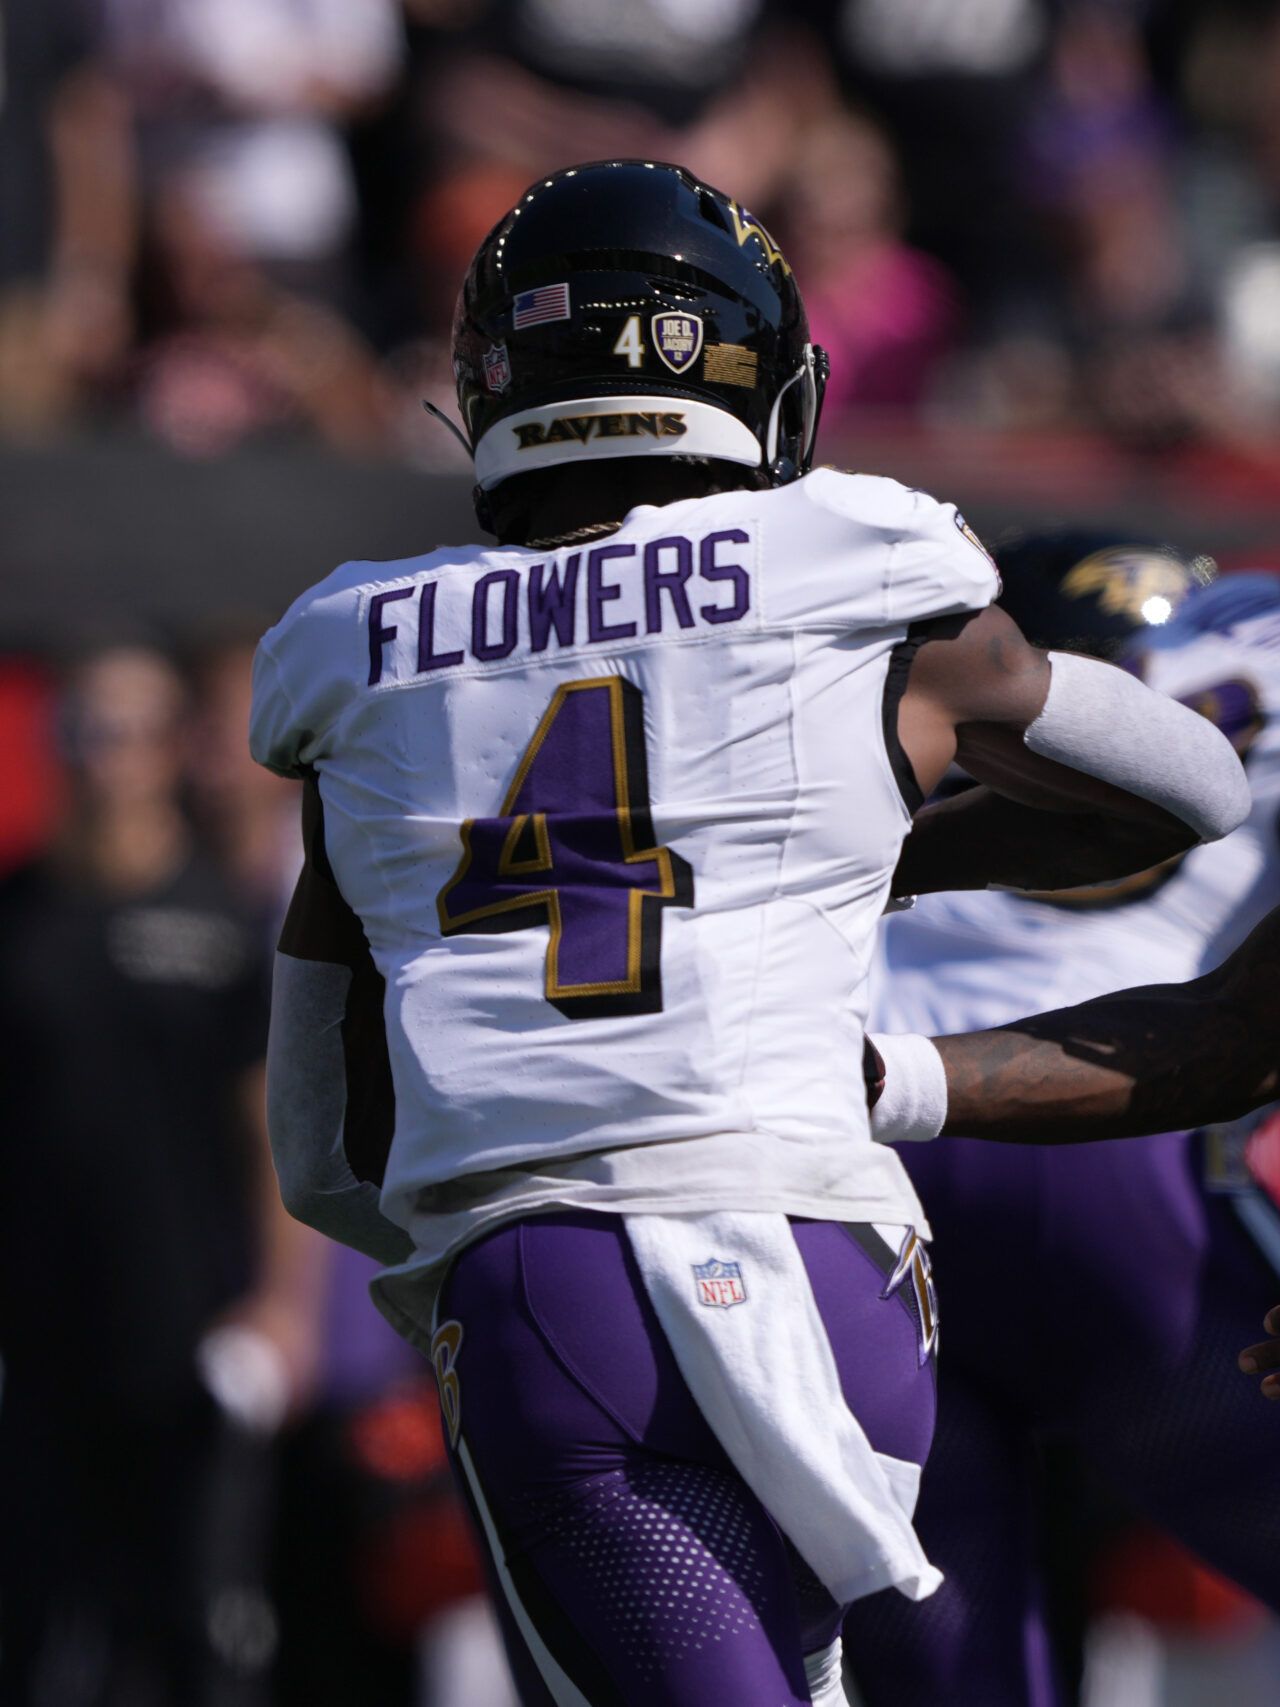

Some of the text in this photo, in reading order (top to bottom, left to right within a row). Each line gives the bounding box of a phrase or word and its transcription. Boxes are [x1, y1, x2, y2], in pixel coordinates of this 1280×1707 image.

[613, 315, 645, 367] 4
[512, 412, 687, 450] RAVENS
[368, 528, 751, 686] FLOWERS
[436, 675, 695, 1020] 4
[699, 1280, 745, 1304] NFL
